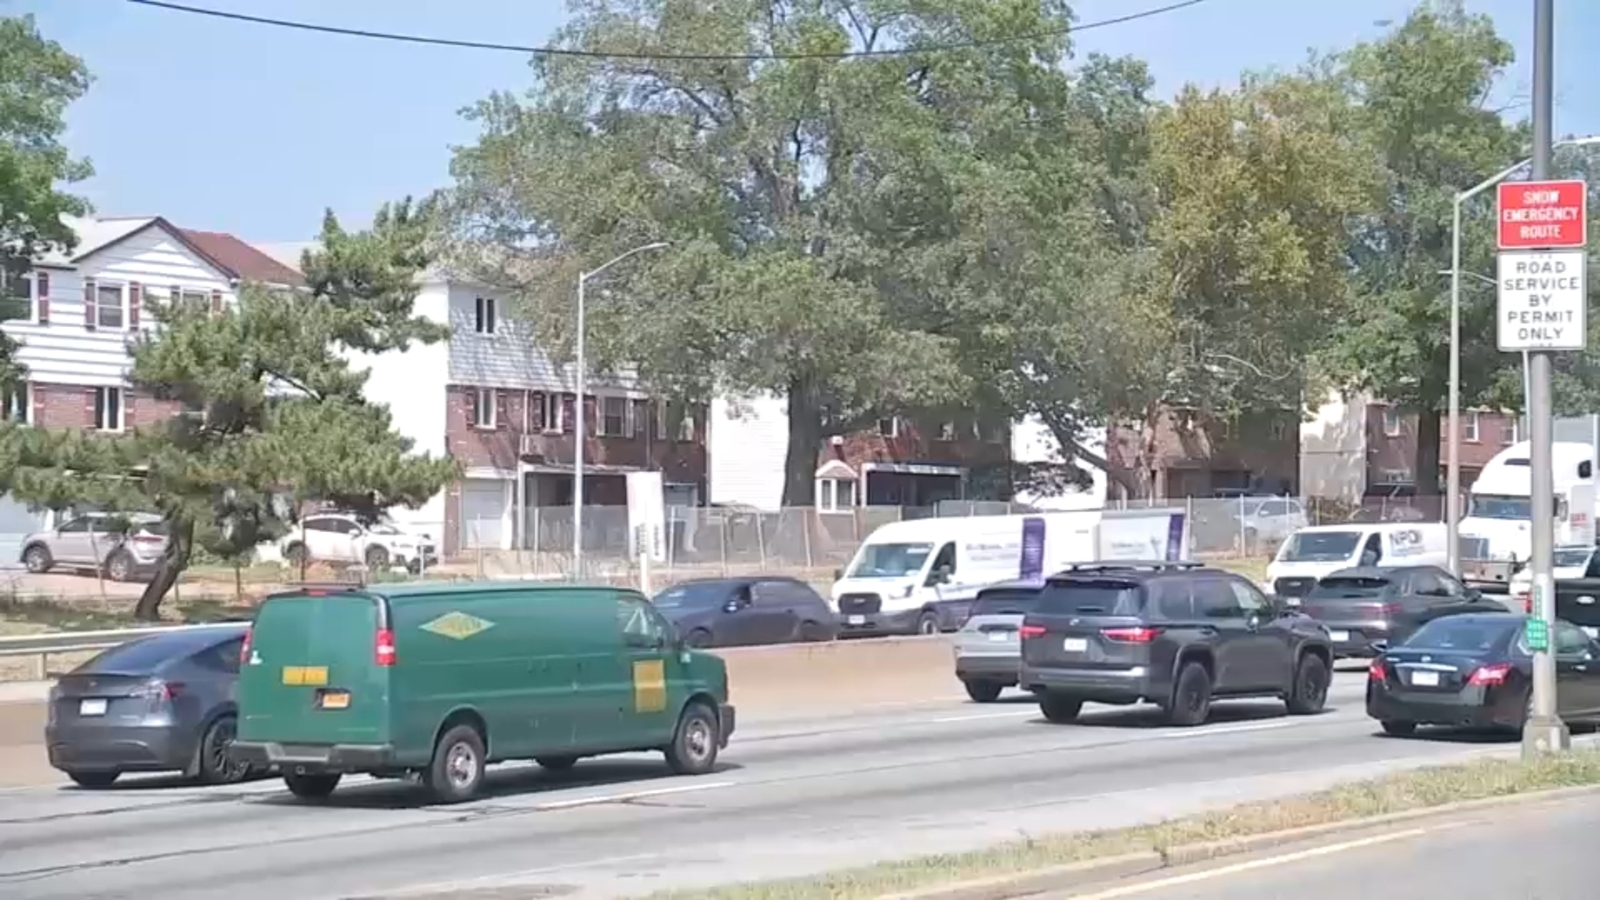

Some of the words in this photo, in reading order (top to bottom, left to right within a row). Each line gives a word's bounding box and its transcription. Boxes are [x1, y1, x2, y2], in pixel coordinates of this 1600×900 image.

[1523, 190, 1560, 204] SNOW
[1503, 207, 1579, 222] EMERGENCY
[1520, 225, 1562, 239] ROUTE
[1516, 261, 1566, 274] ROAD
[1504, 277, 1580, 291] SERVICE
[1529, 294, 1553, 307] BY
[1507, 310, 1573, 324] PERMIT
[1518, 327, 1563, 340] ONLY
